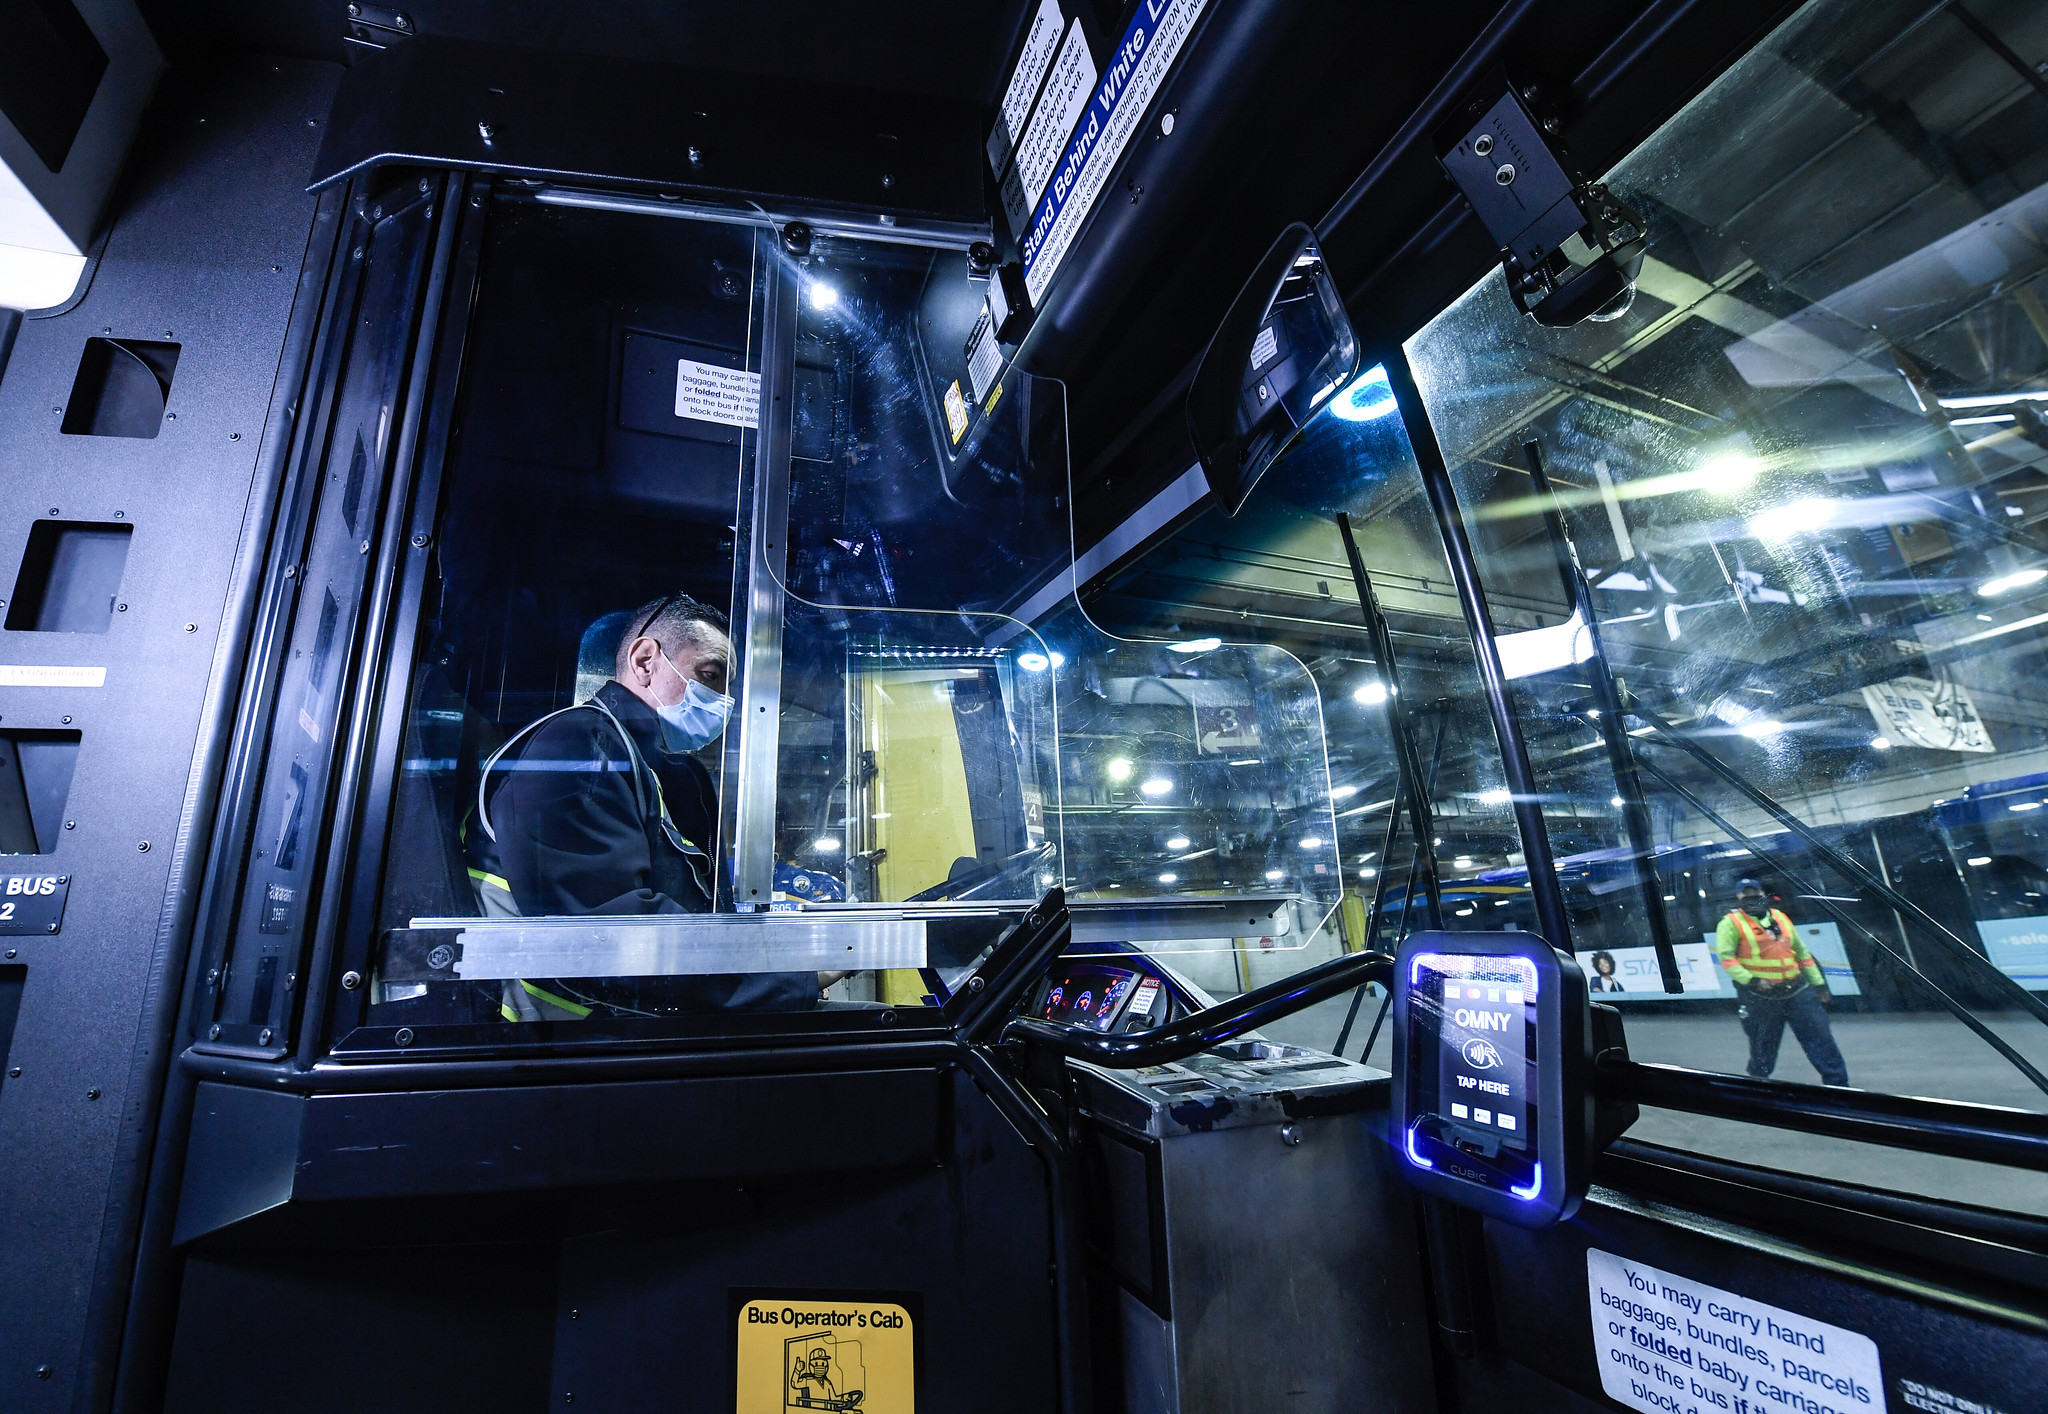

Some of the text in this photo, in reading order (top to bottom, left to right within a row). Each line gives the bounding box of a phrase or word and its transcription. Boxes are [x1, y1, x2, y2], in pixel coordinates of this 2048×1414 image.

[994, 14, 1044, 140] Please do not talk
[1005, 50, 1037, 129] to operator
[1010, 113, 1023, 139] bus
[1020, 98, 1028, 112] is
[1026, 83, 1035, 98] in
[1034, 27, 1060, 83] motion.
[1004, 36, 1077, 196] Please move to the rear.
[1007, 45, 1084, 213] Keep front platform clear.
[1062, 205, 1083, 244] ANYONE
[1080, 196, 1088, 210] IS
[1086, 151, 1112, 201] STANDING
[1111, 101, 1141, 156] FORWARD
[1140, 83, 1150, 104] OF
[1148, 60, 1164, 88] THE
[1161, 21, 1186, 64] WHITE
[1013, 70, 1084, 217] Use rear doors for exit.
[1022, 27, 1146, 266] Stand Behind White
[1039, 220, 1064, 268] PASSENGER
[1079, 150, 1102, 192] FEDERAL
[1100, 125, 1114, 152] LAW
[1112, 70, 1145, 130] PROHIBITS
[1143, 2, 1181, 73] OPERATION
[1032, 128, 1068, 196] Thank you.
[682, 374, 718, 389] baggage,
[695, 365, 711, 377] You
[711, 370, 729, 382] may
[749, 375, 760, 385] han
[683, 396, 702, 405] onto
[702, 398, 716, 407] the
[717, 401, 732, 409] bus
[684, 386, 693, 394] or
[694, 386, 721, 399] folded
[722, 392, 742, 404] baby
[689, 406, 712, 416] block
[712, 411, 736, 421] doors
[1220, 707, 1238, 733] 3
[1028, 803, 1038, 822] 4
[6, 877, 57, 896] BUS
[1143, 979, 1161, 988] NOTICE
[1623, 957, 1694, 976] STAH
[1454, 1008, 1512, 1032] OMNY
[1456, 1074, 1511, 1097] TAP HERE
[1450, 1164, 1488, 1183] CUBIC
[748, 1307, 904, 1329] Bus Operator's Cab
[1624, 1268, 1825, 1355] You may carry hand
[1600, 1287, 1871, 1404] baggage, bundles, parcels
[1608, 1321, 1847, 1414] or folded baby carria
[1610, 1348, 1650, 1375] onto
[1653, 1362, 1685, 1390] the
[1690, 1376, 1729, 1410] bus
[1733, 1394, 1749, 1414] if
[1630, 1378, 1681, 1414] block
